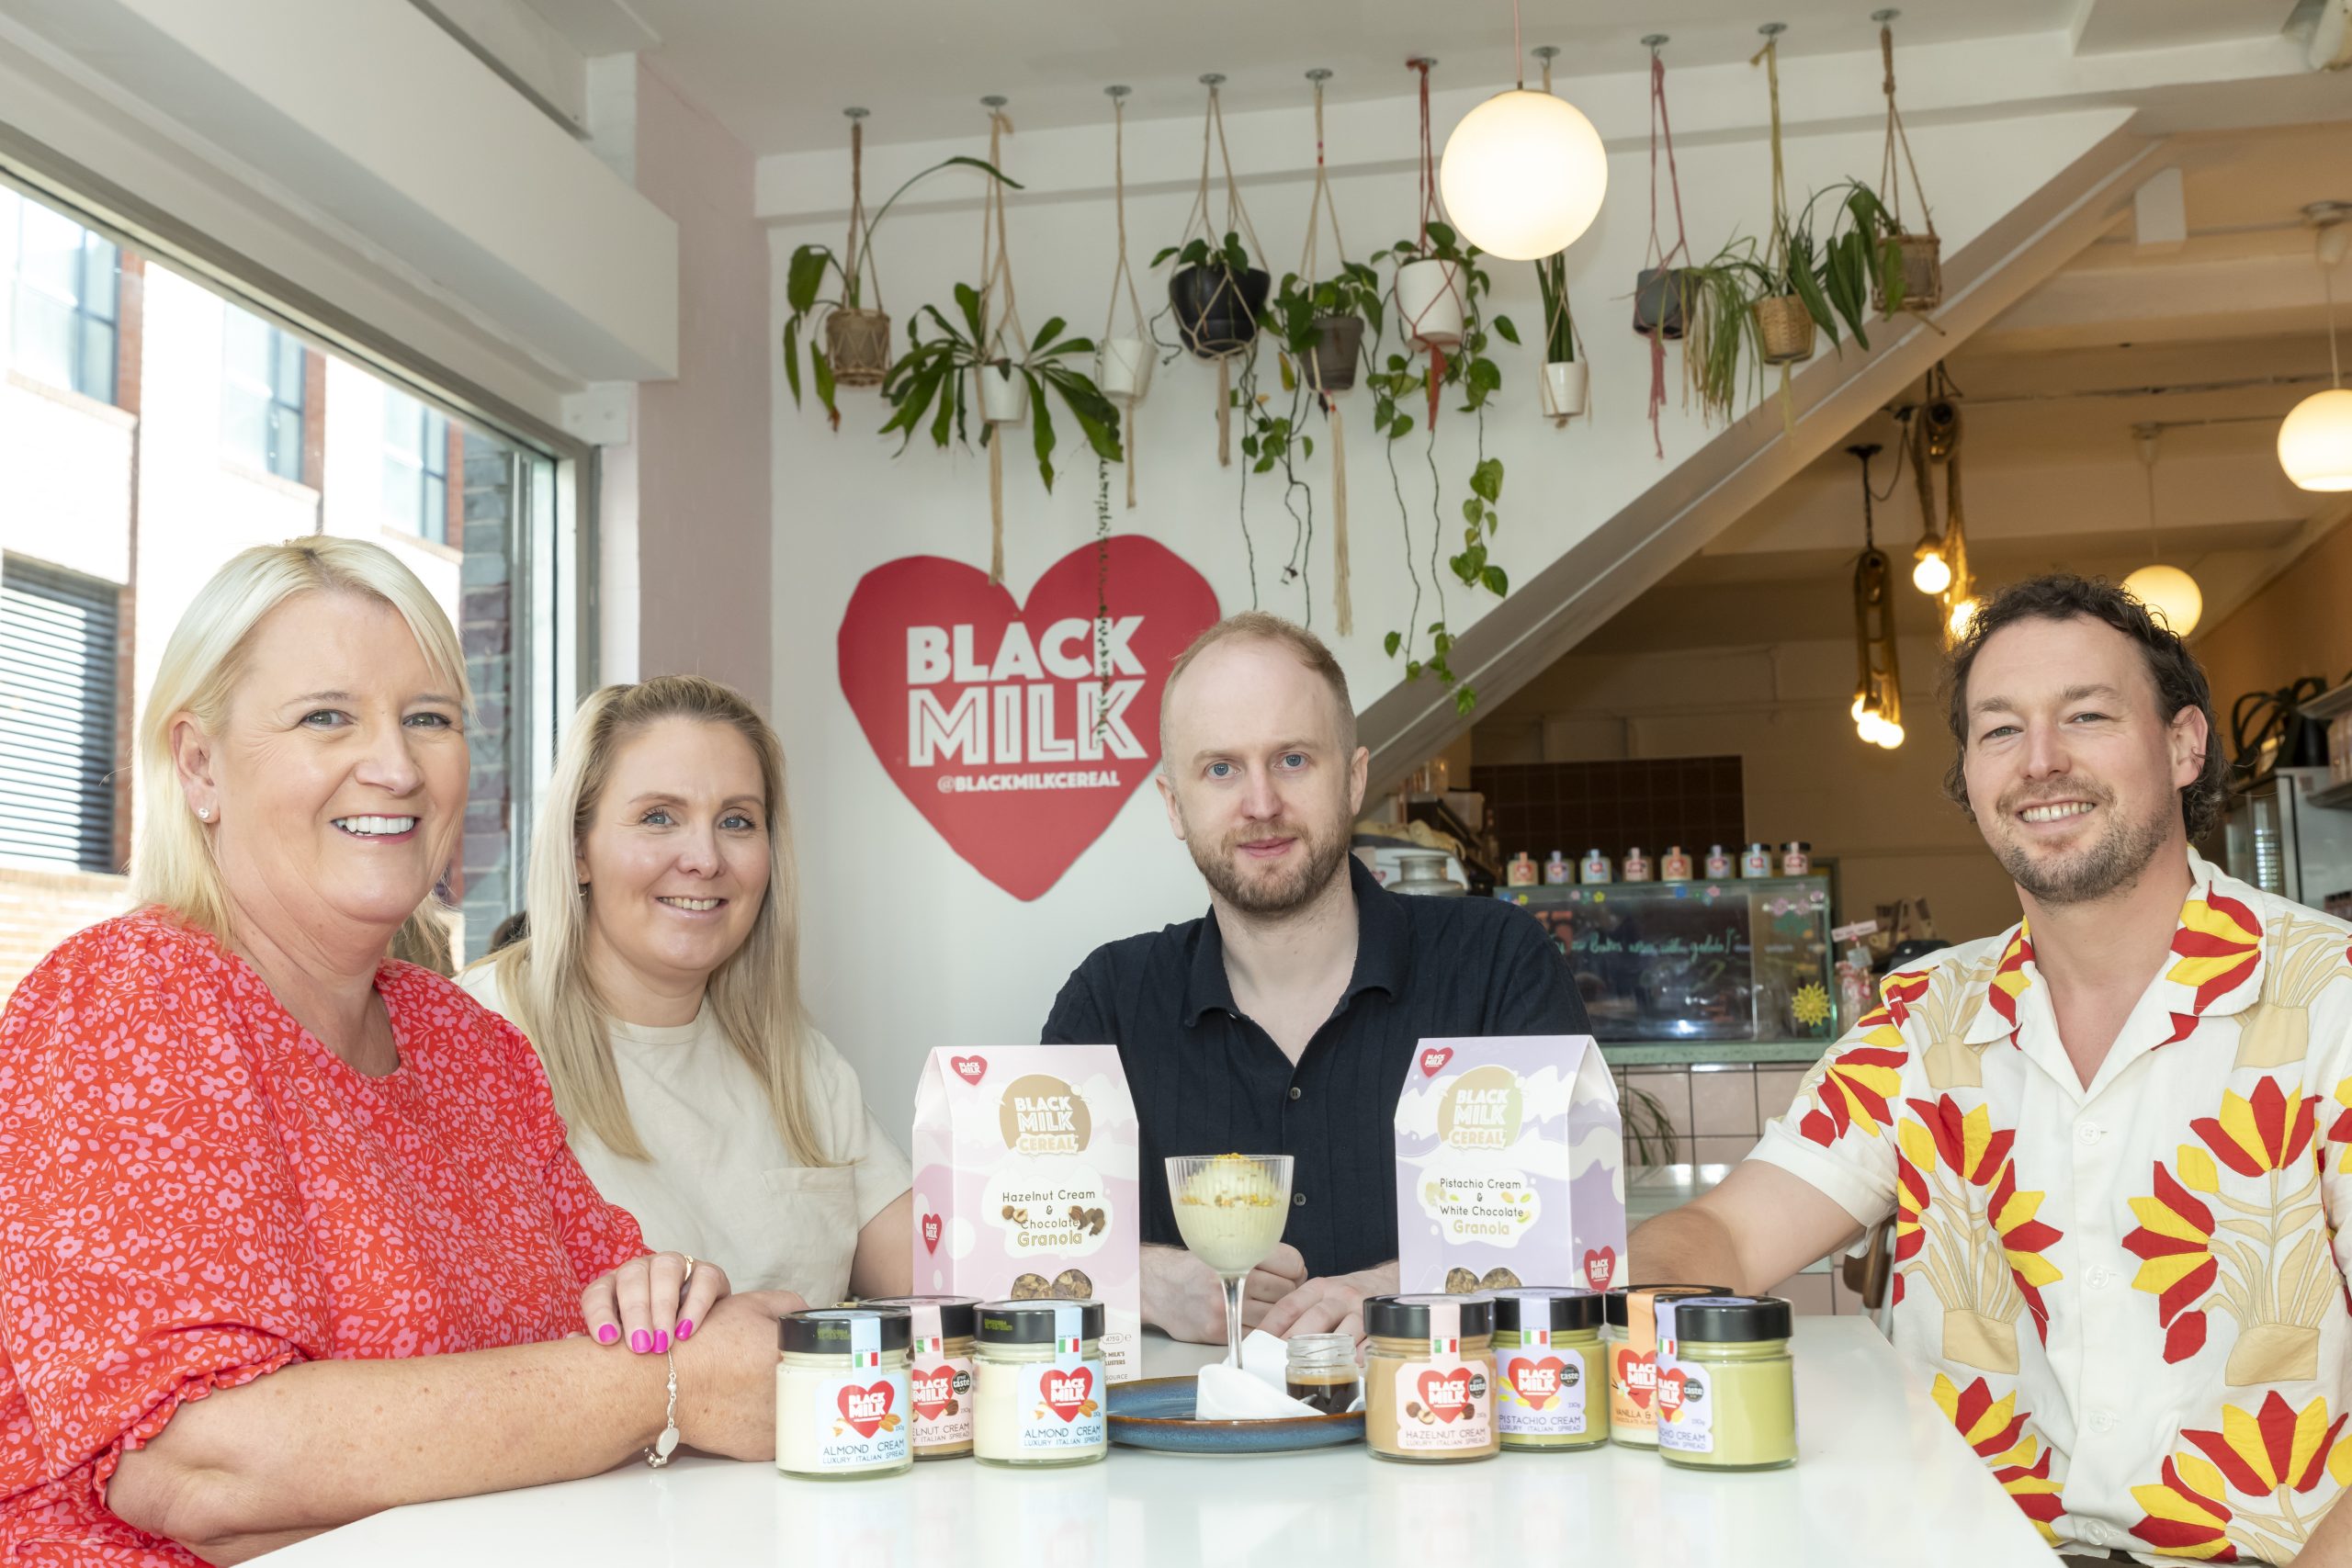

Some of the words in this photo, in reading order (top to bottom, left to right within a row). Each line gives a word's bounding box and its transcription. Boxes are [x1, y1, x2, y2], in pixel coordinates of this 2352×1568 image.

[907, 615, 1147, 684] BLACK
[908, 680, 1148, 767] MILK
[937, 770, 1121, 793] @BLACKMILKCEREAL
[1425, 1058, 1443, 1066] MILK
[1456, 1089, 1510, 1104] BLACK
[1013, 1096, 1073, 1111] BLACK
[1453, 1103, 1508, 1125] MILK
[1016, 1111, 1076, 1133] MILK
[1018, 1135, 1075, 1152] CEREAL
[1451, 1130, 1505, 1145] CEREAL
[1440, 1179, 1484, 1190] Pistachio
[1487, 1178, 1521, 1190] Cream
[1002, 1190, 1054, 1203] Hazelnut
[1057, 1189, 1095, 1201] Cream
[1476, 1192, 1483, 1201] &
[1046, 1204, 1053, 1215] &
[1440, 1205, 1468, 1216] White
[1471, 1205, 1523, 1217] Chocolate
[1021, 1218, 1080, 1230] Chocolate
[1453, 1220, 1510, 1235] Granola
[1017, 1231, 1082, 1247] Granola
[1590, 1258, 1609, 1269] BLACK
[1590, 1267, 1609, 1280] MILK
[1518, 1369, 1555, 1379] BLACK
[1560, 1372, 1579, 1381] taste
[912, 1378, 949, 1390] BLACK
[953, 1380, 970, 1388] taste
[1050, 1378, 1085, 1390] BLACK
[1428, 1380, 1465, 1392] BLACK
[1469, 1382, 1486, 1391] taste
[1518, 1377, 1556, 1392] MILK
[912, 1387, 949, 1403] MILK
[1050, 1387, 1085, 1403] MILK
[1428, 1390, 1466, 1404] MILK
[1683, 1387, 1703, 1395] taste
[848, 1392, 886, 1405] BLACK
[848, 1402, 887, 1418] MILK
[1615, 1408, 1641, 1418] VANILLA
[1645, 1411, 1651, 1419] &
[1499, 1415, 1546, 1425] PISTACHIO
[1551, 1416, 1580, 1426] CREAM
[943, 1423, 970, 1434] CREAM
[1024, 1427, 1069, 1438] ALMOND
[1076, 1425, 1101, 1437] CREAM
[1406, 1429, 1455, 1439] HAZELNUT
[1459, 1428, 1485, 1438] CREAM
[921, 1435, 946, 1443] ITALIAN
[949, 1432, 970, 1440] SPREAD
[1023, 1438, 1051, 1447] LUXURY
[1676, 1431, 1706, 1442] CREAM
[823, 1444, 869, 1456] ALMOND
[877, 1438, 904, 1452] CREAM
[1682, 1441, 1706, 1450] SPREAD
[822, 1456, 851, 1464] LUXURY
[855, 1453, 882, 1462] ITALIAN
[886, 1450, 904, 1459] SPREAD
